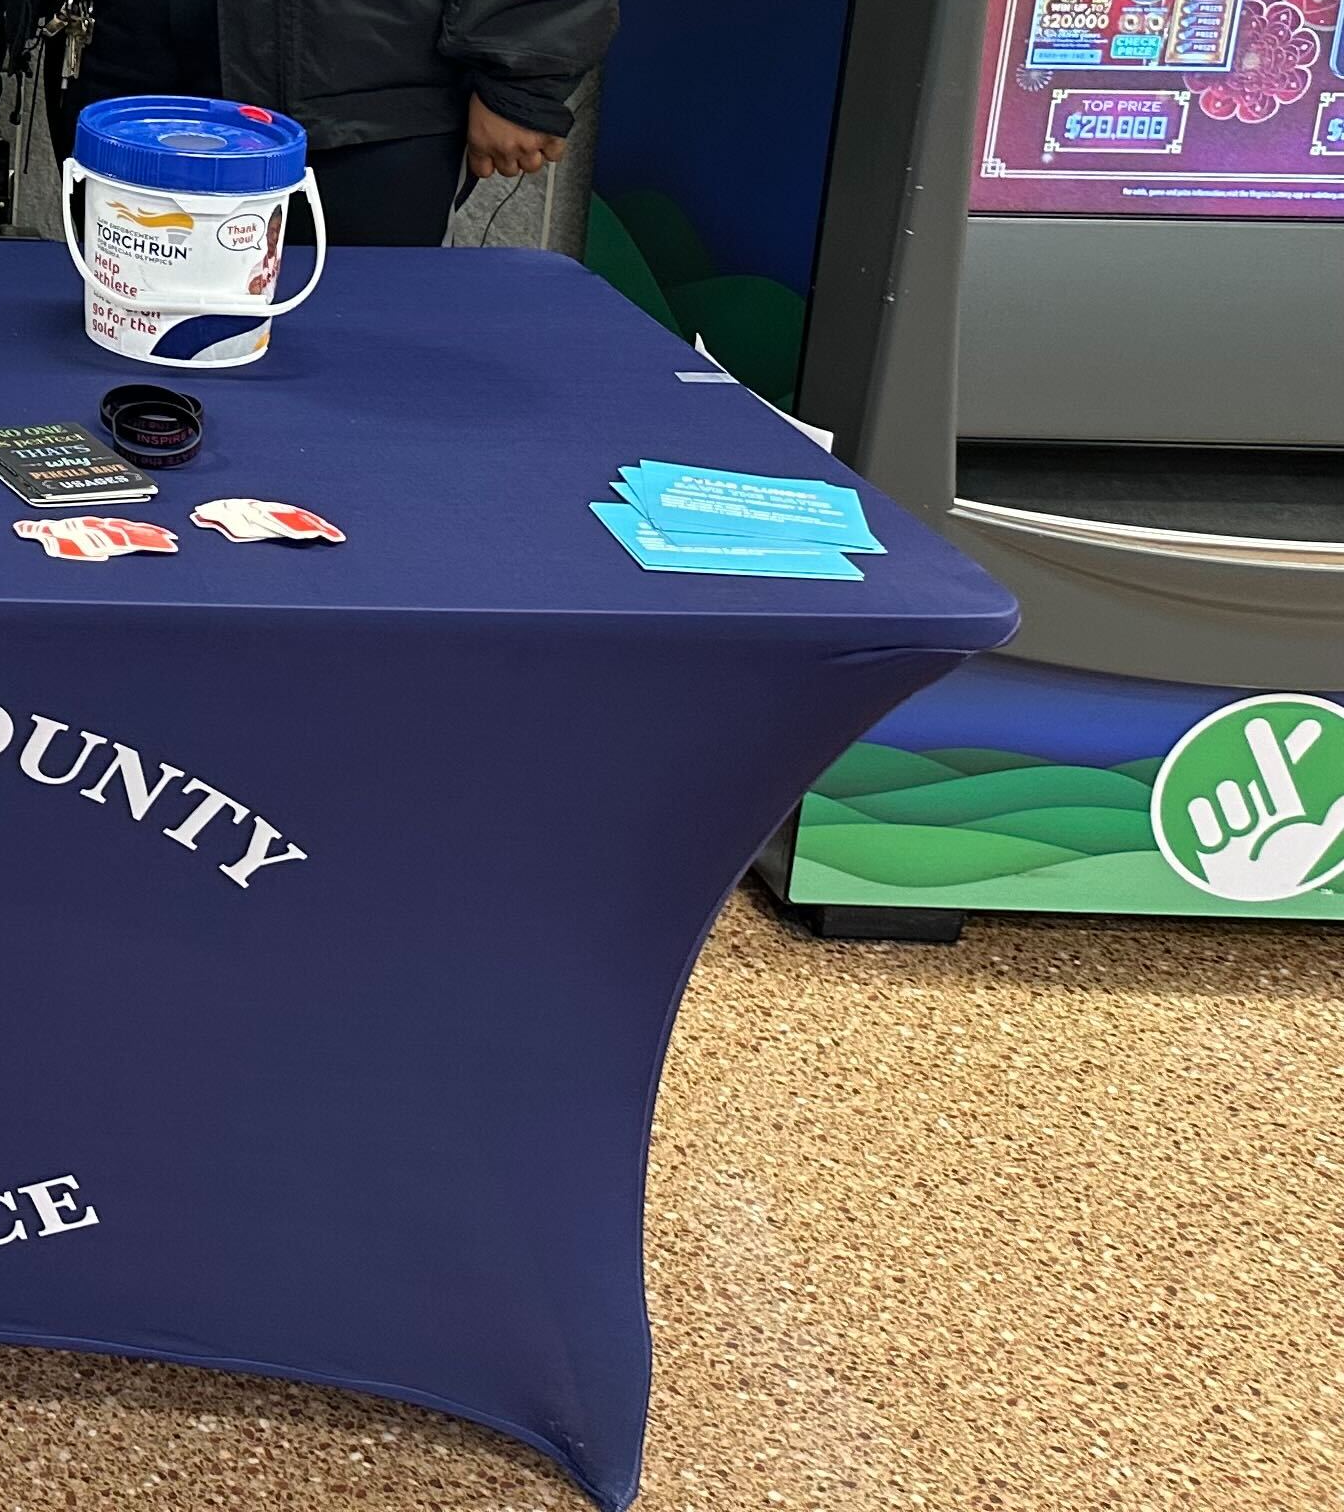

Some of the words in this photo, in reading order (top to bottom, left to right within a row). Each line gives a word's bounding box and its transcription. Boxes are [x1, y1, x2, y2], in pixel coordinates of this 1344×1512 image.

[1115, 36, 1158, 47] CHECK
[1081, 99, 1113, 113] TOP
[1117, 99, 1162, 113] PRIZE
[226, 222, 258, 236] Thank
[96, 221, 146, 252] TORCH
[148, 241, 188, 260] RUN
[231, 235, 255, 248] you!
[94, 252, 120, 276] Help
[92, 302, 105, 317] go
[107, 308, 126, 327] for
[130, 317, 158, 336] the
[92, 317, 119, 341] gold.
[24, 423, 68, 436] ONE
[44, 456, 92, 468] why
